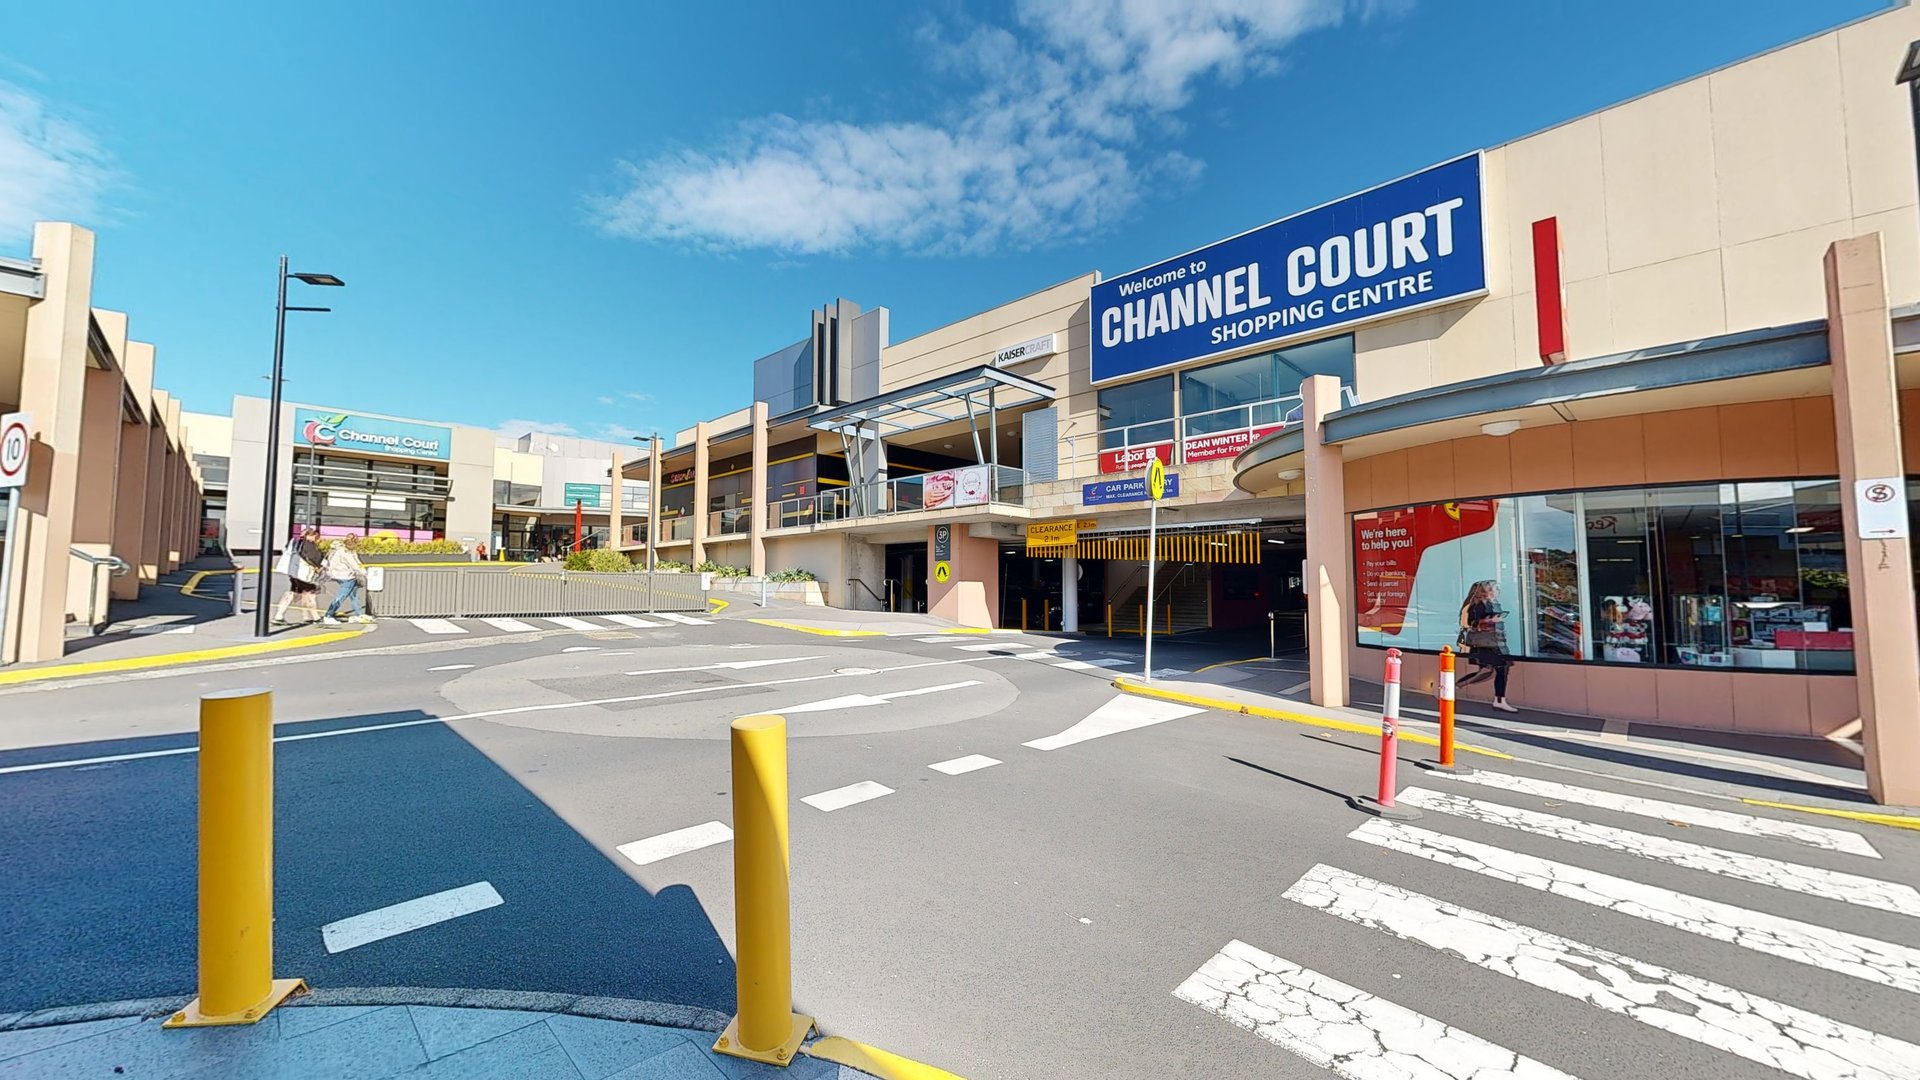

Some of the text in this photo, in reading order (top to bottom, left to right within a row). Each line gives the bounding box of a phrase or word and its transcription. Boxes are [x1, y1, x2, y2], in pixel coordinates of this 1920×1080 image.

[1101, 197, 1463, 348] CHANNEL COURT
[1118, 259, 1207, 297] Welcome to
[1210, 270, 1434, 345] SHOPPING CENTRE
[998, 339, 1051, 363] KAISERCRAFT
[338, 429, 439, 450] Channel Court
[1185, 440, 1210, 450] DEAN
[1211, 433, 1248, 447] WINTER
[7, 438, 21, 461] 10
[1187, 448, 1216, 458] Member
[1217, 446, 1228, 455] for
[1115, 452, 1145, 463] Labor
[1123, 482, 1144, 490] PARK
[938, 531, 947, 540] 3P
[1030, 524, 1073, 533] CLEARANCE
[1361, 528, 1407, 539] We're here
[1361, 537, 1413, 551] to help you!
